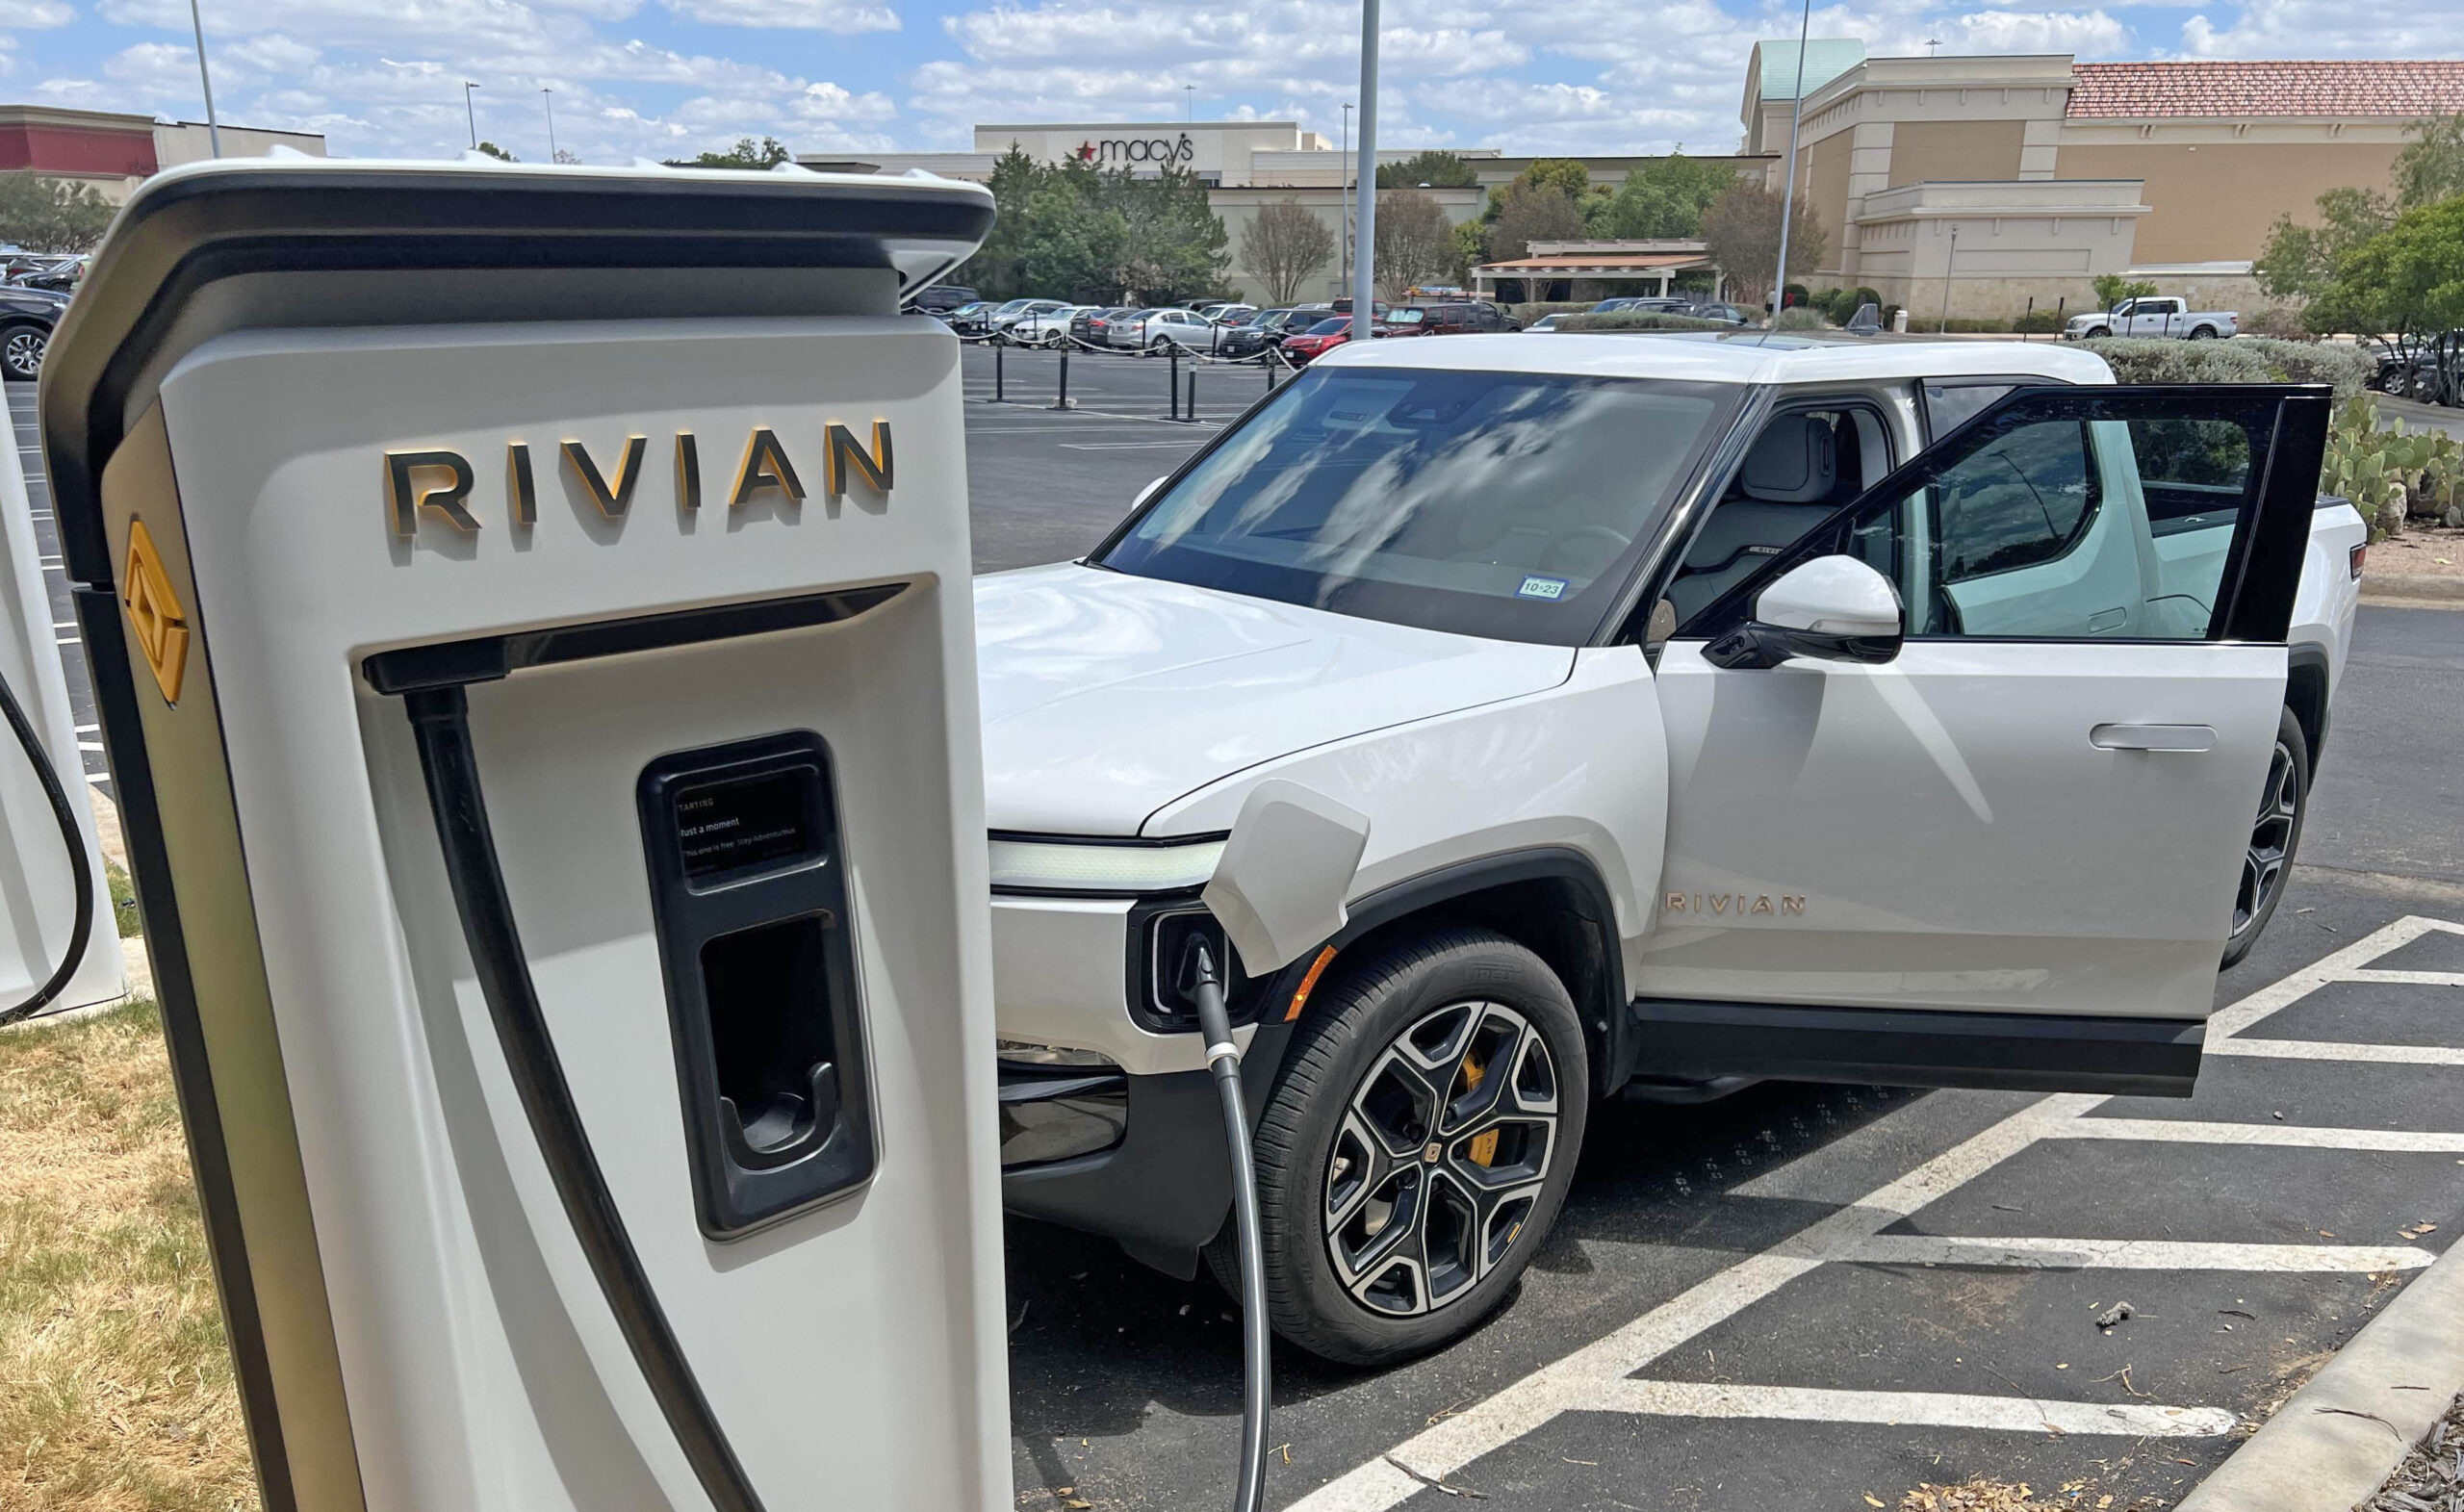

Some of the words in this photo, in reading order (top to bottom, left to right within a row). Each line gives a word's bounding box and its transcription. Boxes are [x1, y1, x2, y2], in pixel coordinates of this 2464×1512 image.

[1100, 133, 1194, 167] macy's
[385, 421, 894, 536] RIVIAN
[678, 798, 714, 812] TARTING
[706, 817, 740, 832] moment
[1665, 891, 1806, 916] RIVIAN
